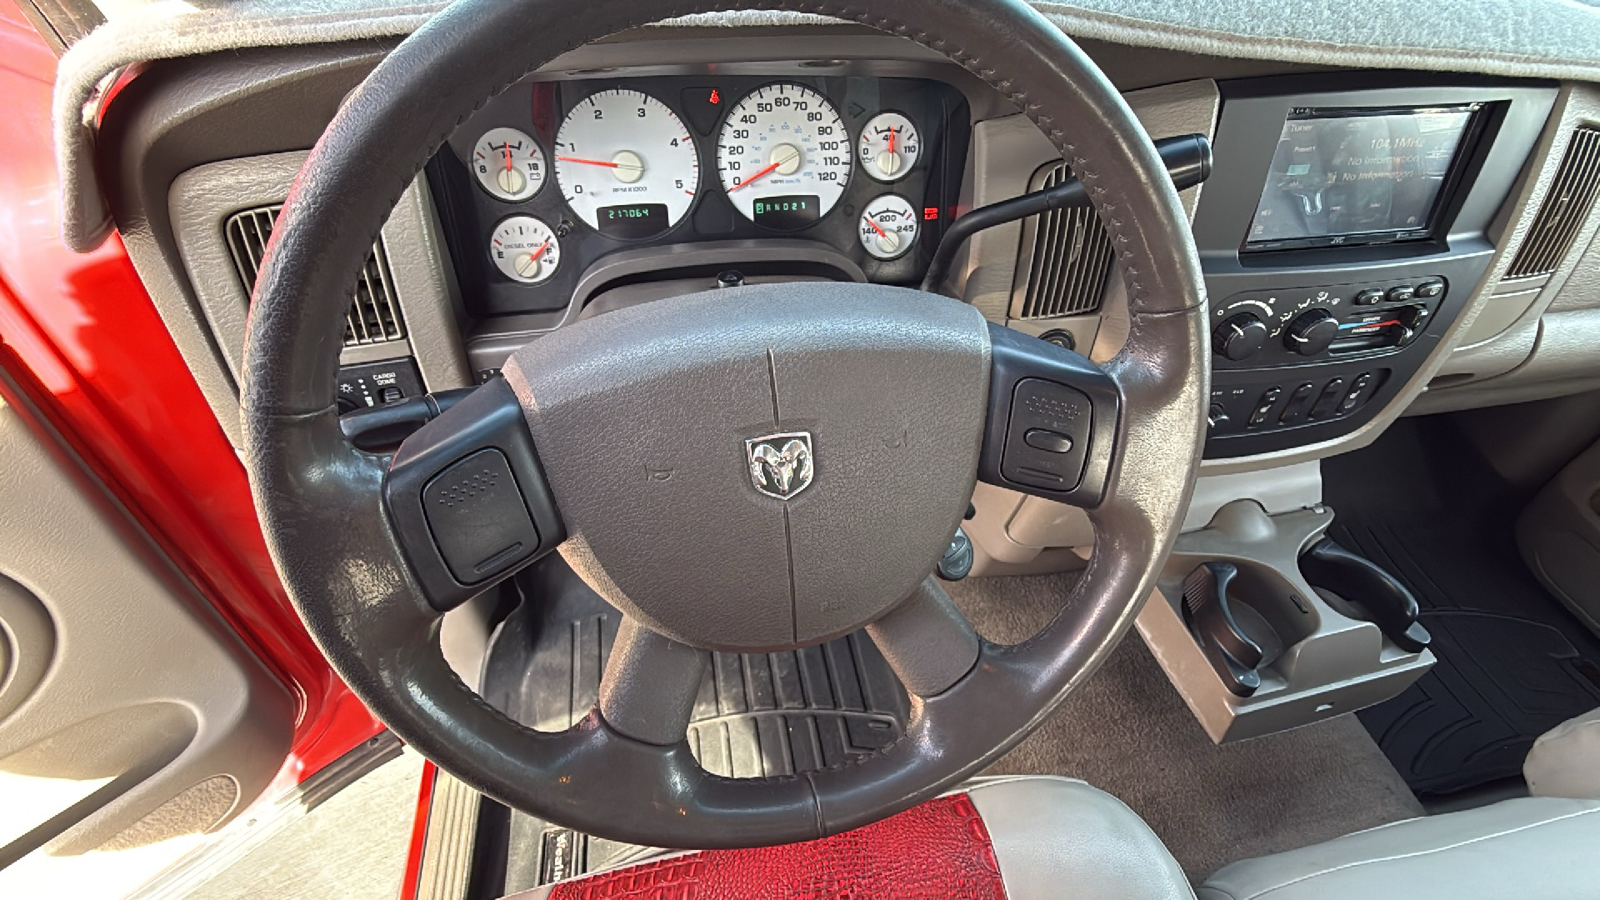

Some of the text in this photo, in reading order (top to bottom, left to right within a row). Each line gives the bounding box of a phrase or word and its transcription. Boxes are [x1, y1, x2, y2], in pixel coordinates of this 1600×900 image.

[774, 98, 790, 107] 60
[792, 102, 808, 111] 70
[757, 103, 772, 112] 50
[594, 110, 603, 119] 2
[638, 108, 646, 118] 3
[807, 112, 822, 122] 80
[740, 114, 757, 124] 40
[733, 130, 749, 139] 30
[818, 126, 832, 136] 90
[570, 143, 575, 152] 1
[670, 138, 678, 148] 4
[819, 142, 838, 150] 100
[728, 146, 744, 155] 20
[862, 148, 869, 156] 0
[904, 146, 916, 154] 110
[728, 162, 741, 170] 10
[823, 157, 840, 166] 110
[480, 165, 488, 174] 8
[528, 162, 539, 171] 18
[732, 176, 741, 186] 0
[818, 172, 837, 182] 120
[1342, 172, 1356, 181] No
[675, 180, 684, 189] 5
[574, 185, 583, 194] 0
[608, 208, 649, 219] 217064
[896, 224, 914, 232] 245
[372, 372, 396, 380] CARGO
